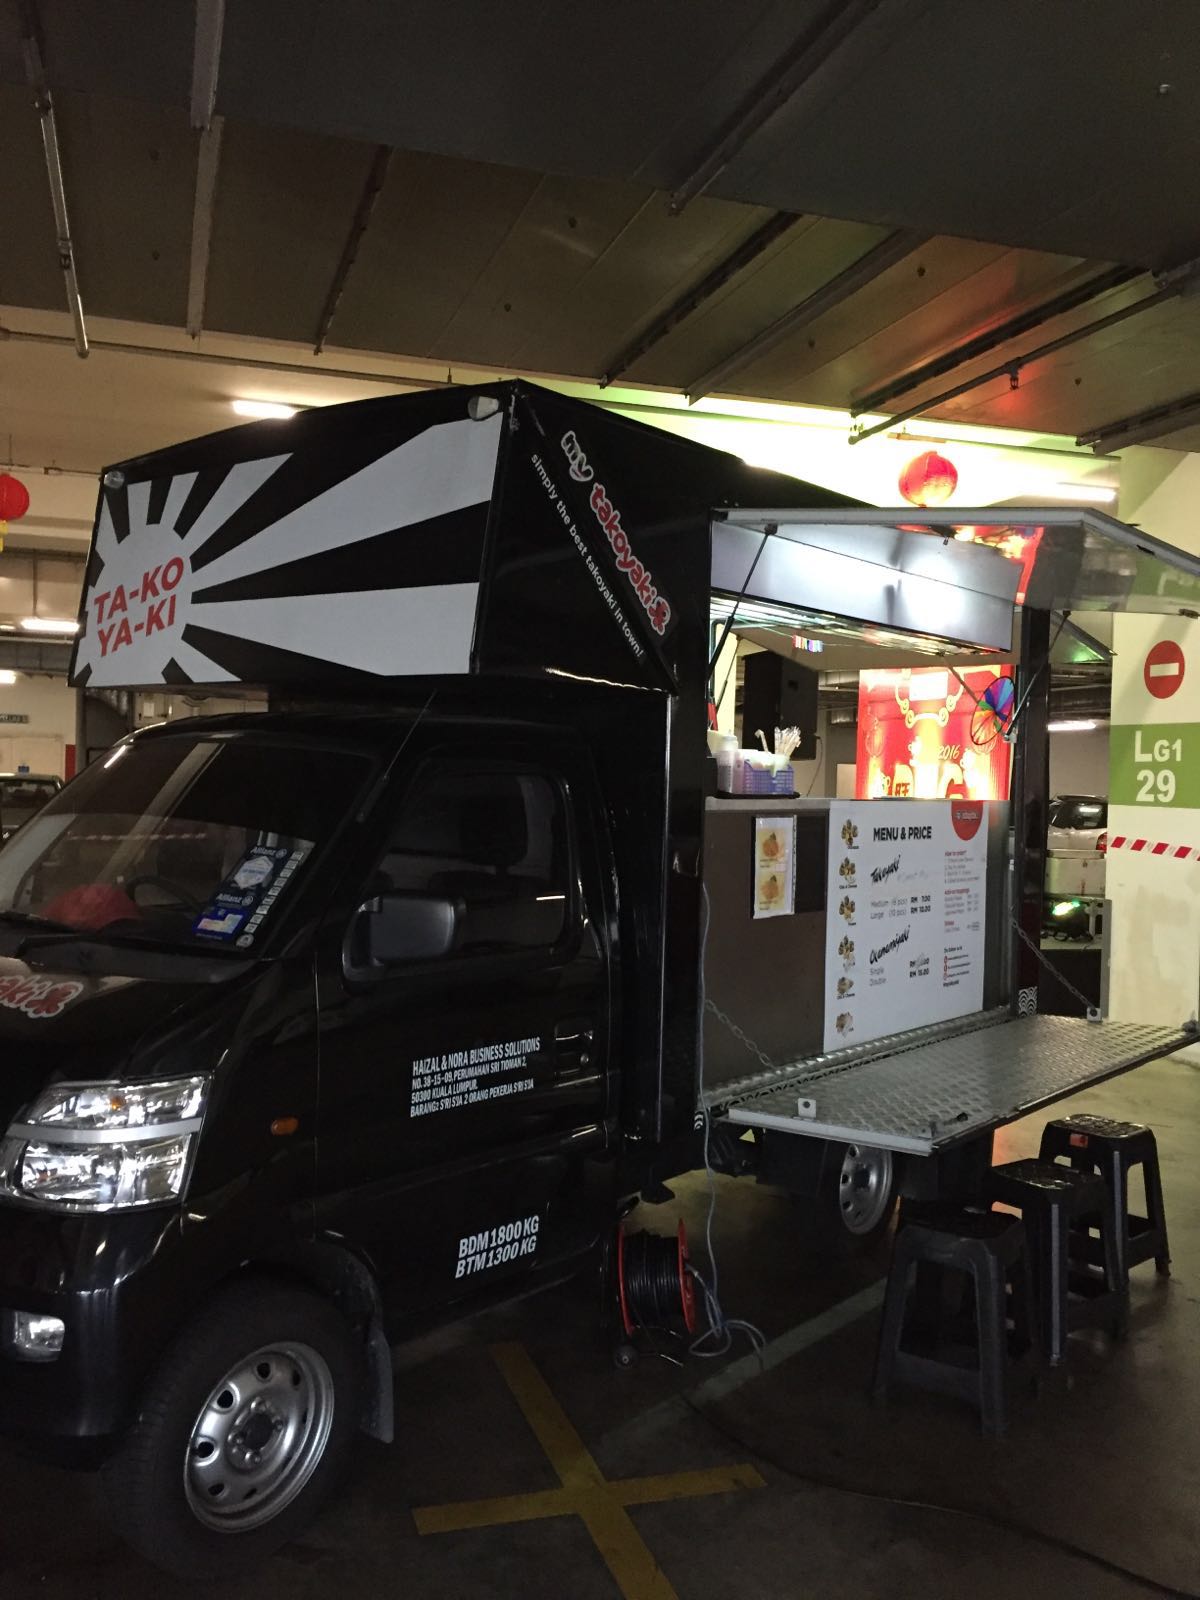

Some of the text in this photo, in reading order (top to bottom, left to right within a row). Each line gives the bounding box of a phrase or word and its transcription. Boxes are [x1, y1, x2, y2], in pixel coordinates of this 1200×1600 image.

[531, 454, 645, 657] simply the best takoyaki in town!
[590, 482, 658, 610] takoyaki
[94, 556, 185, 626] TA-KO
[97, 593, 177, 658] YA-KI
[938, 744, 961, 761] 2016
[1134, 730, 1183, 763] LG1
[1135, 769, 1177, 803] 29
[873, 825, 932, 842] MENU & PRICE
[411, 1078, 422, 1091] NO.
[453, 1062, 490, 1081] PERUMAHAN
[500, 1057, 522, 1072] TIOMAN
[412, 1037, 540, 1076] HAIZAL & NORA BUSINESS SOLUTIONS
[431, 1084, 453, 1100] KUALA
[452, 1079, 478, 1095] LUMPUR.
[463, 1092, 469, 1105] 2
[468, 1088, 489, 1104] ORANG
[488, 1082, 513, 1099] PEKERJA
[458, 1215, 540, 1259] BDM 1800 KG
[455, 1235, 537, 1279] BTM 1300 KG
